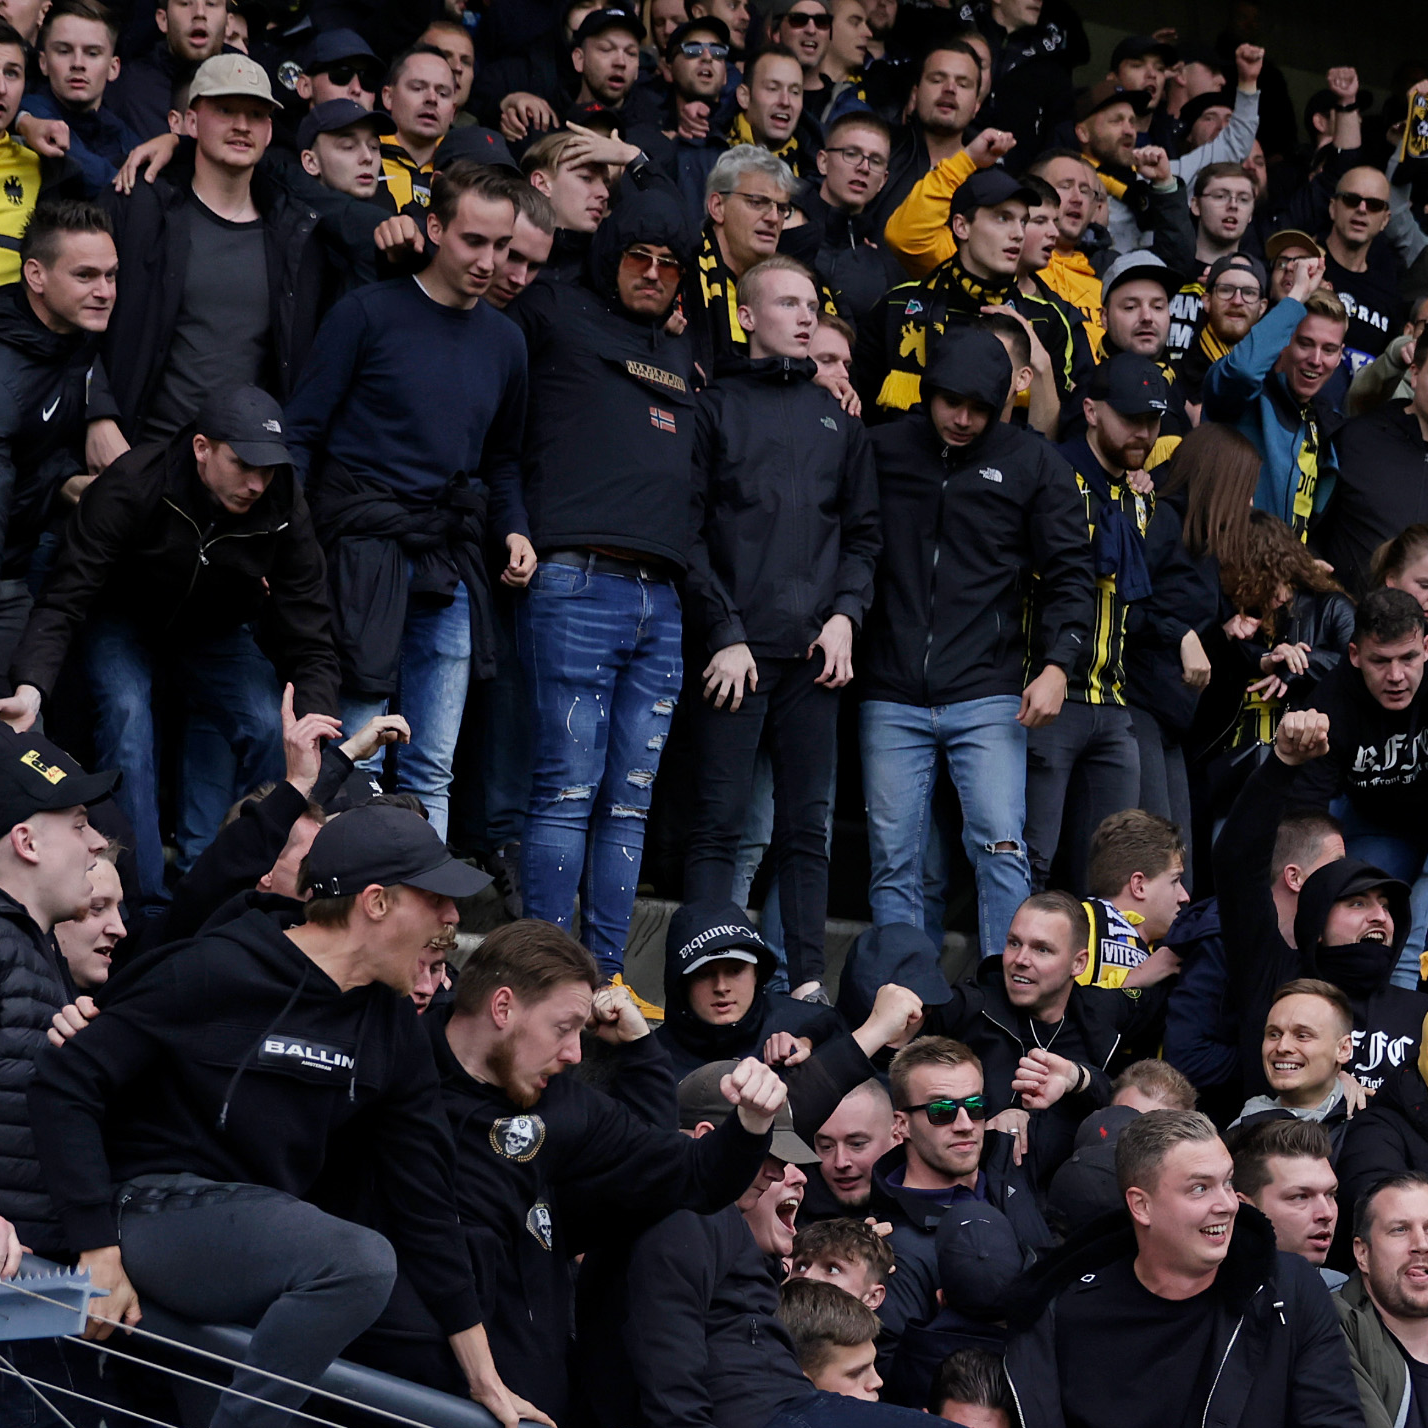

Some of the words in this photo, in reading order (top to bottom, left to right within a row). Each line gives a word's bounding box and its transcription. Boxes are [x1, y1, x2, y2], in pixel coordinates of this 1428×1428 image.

[678, 924, 755, 959] Columbia
[1103, 942, 1148, 967] VITESS
[264, 1039, 355, 1070] BALLIN
[1350, 1029, 1415, 1073] FFC
